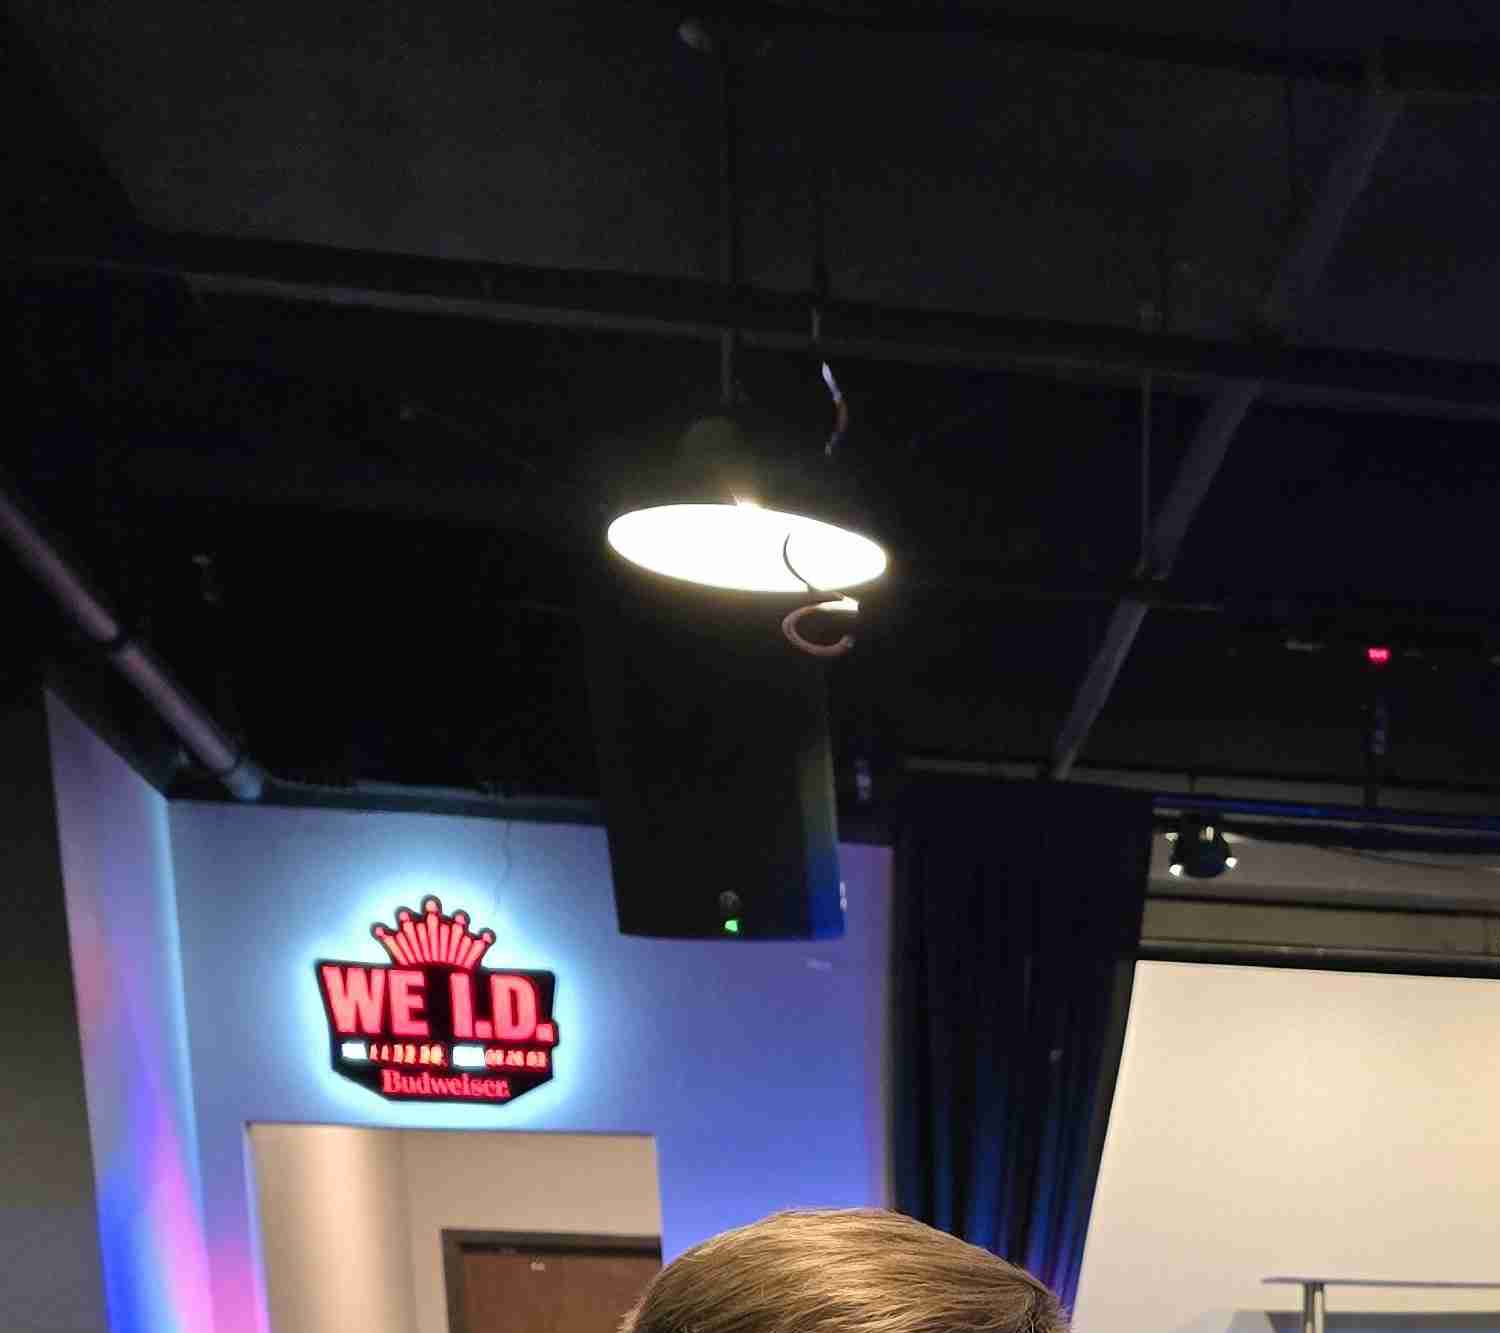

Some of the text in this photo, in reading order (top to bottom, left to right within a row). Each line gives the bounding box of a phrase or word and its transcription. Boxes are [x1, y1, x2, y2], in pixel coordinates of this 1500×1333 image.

[321, 966, 554, 1042] WE I.D.
[381, 1068, 511, 1098] Budweiser
